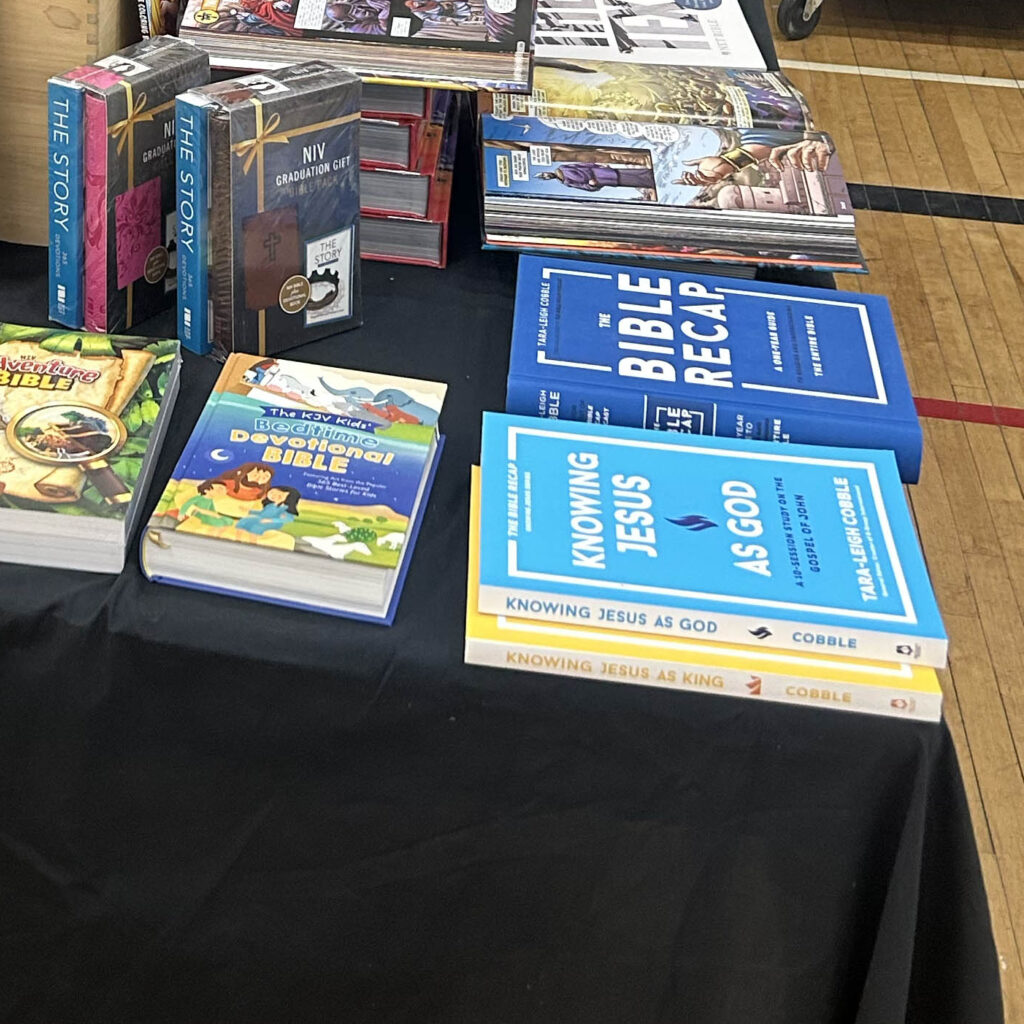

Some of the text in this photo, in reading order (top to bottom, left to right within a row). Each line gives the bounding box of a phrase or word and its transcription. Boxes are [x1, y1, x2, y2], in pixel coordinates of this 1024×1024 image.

[164, 122, 176, 139] NI
[303, 142, 326, 164] NIV
[52, 98, 70, 233] THE STORY
[179, 114, 195, 254] THE STORY
[276, 155, 351, 187] GRADUATION GIFT
[314, 247, 343, 265] STORY
[320, 238, 337, 252] THE
[538, 281, 550, 347] TARA-LEIGH COBBLE
[599, 312, 612, 328] THE
[618, 273, 676, 383] BIBLE
[679, 280, 734, 388] RECAP
[804, 315, 823, 376] THE ENTIRE BIBLE
[254, 418, 379, 448] Bedtime
[270, 408, 372, 429] The KJV Kids'
[230, 429, 394, 465] Devotional
[262, 446, 351, 474] BIBLE
[508, 462, 519, 536] THE BIBLE RECAP
[775, 477, 784, 491] THE
[780, 492, 787, 506] ON
[832, 476, 856, 525] COBBLE
[567, 451, 606, 570] KNOWING
[612, 473, 657, 558] JESUS
[721, 479, 771, 577] AS GOD
[783, 507, 794, 533] STUDY
[794, 494, 821, 574] GOSPEL OF JOHN
[789, 532, 803, 576] 10-SESSION
[849, 522, 879, 602] TARA-LEIGH
[506, 597, 857, 649] KNOWING JESUS AS GOD COBBLE
[506, 651, 852, 704] KNOWING JESUS AS KING COBBLE
